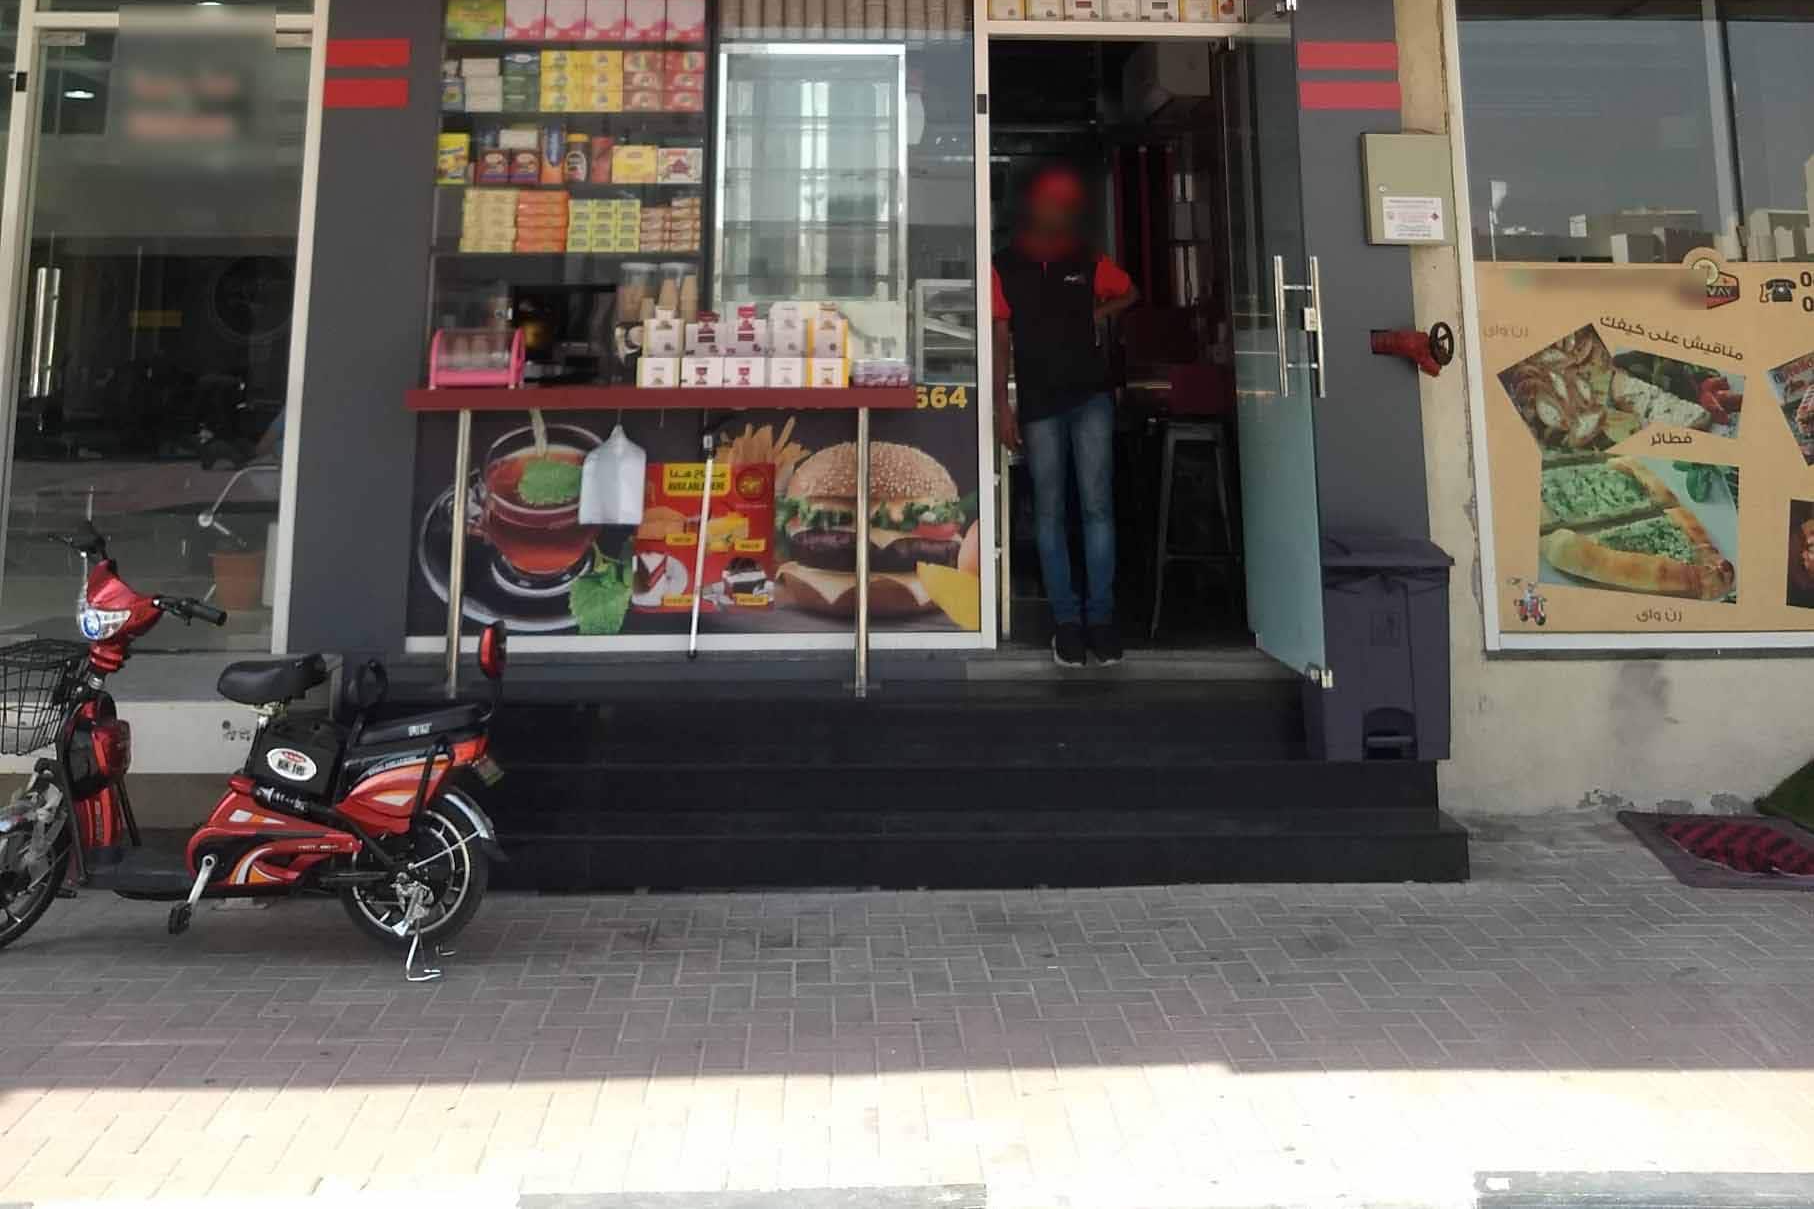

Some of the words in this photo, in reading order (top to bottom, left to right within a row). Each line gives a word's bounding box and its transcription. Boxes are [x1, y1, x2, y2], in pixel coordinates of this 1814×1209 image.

[1600, 315, 1645, 335] كيفك
[1649, 330, 1680, 345] على
[1683, 336, 1744, 361] مناقيش
[1651, 431, 1692, 446] فطائر
